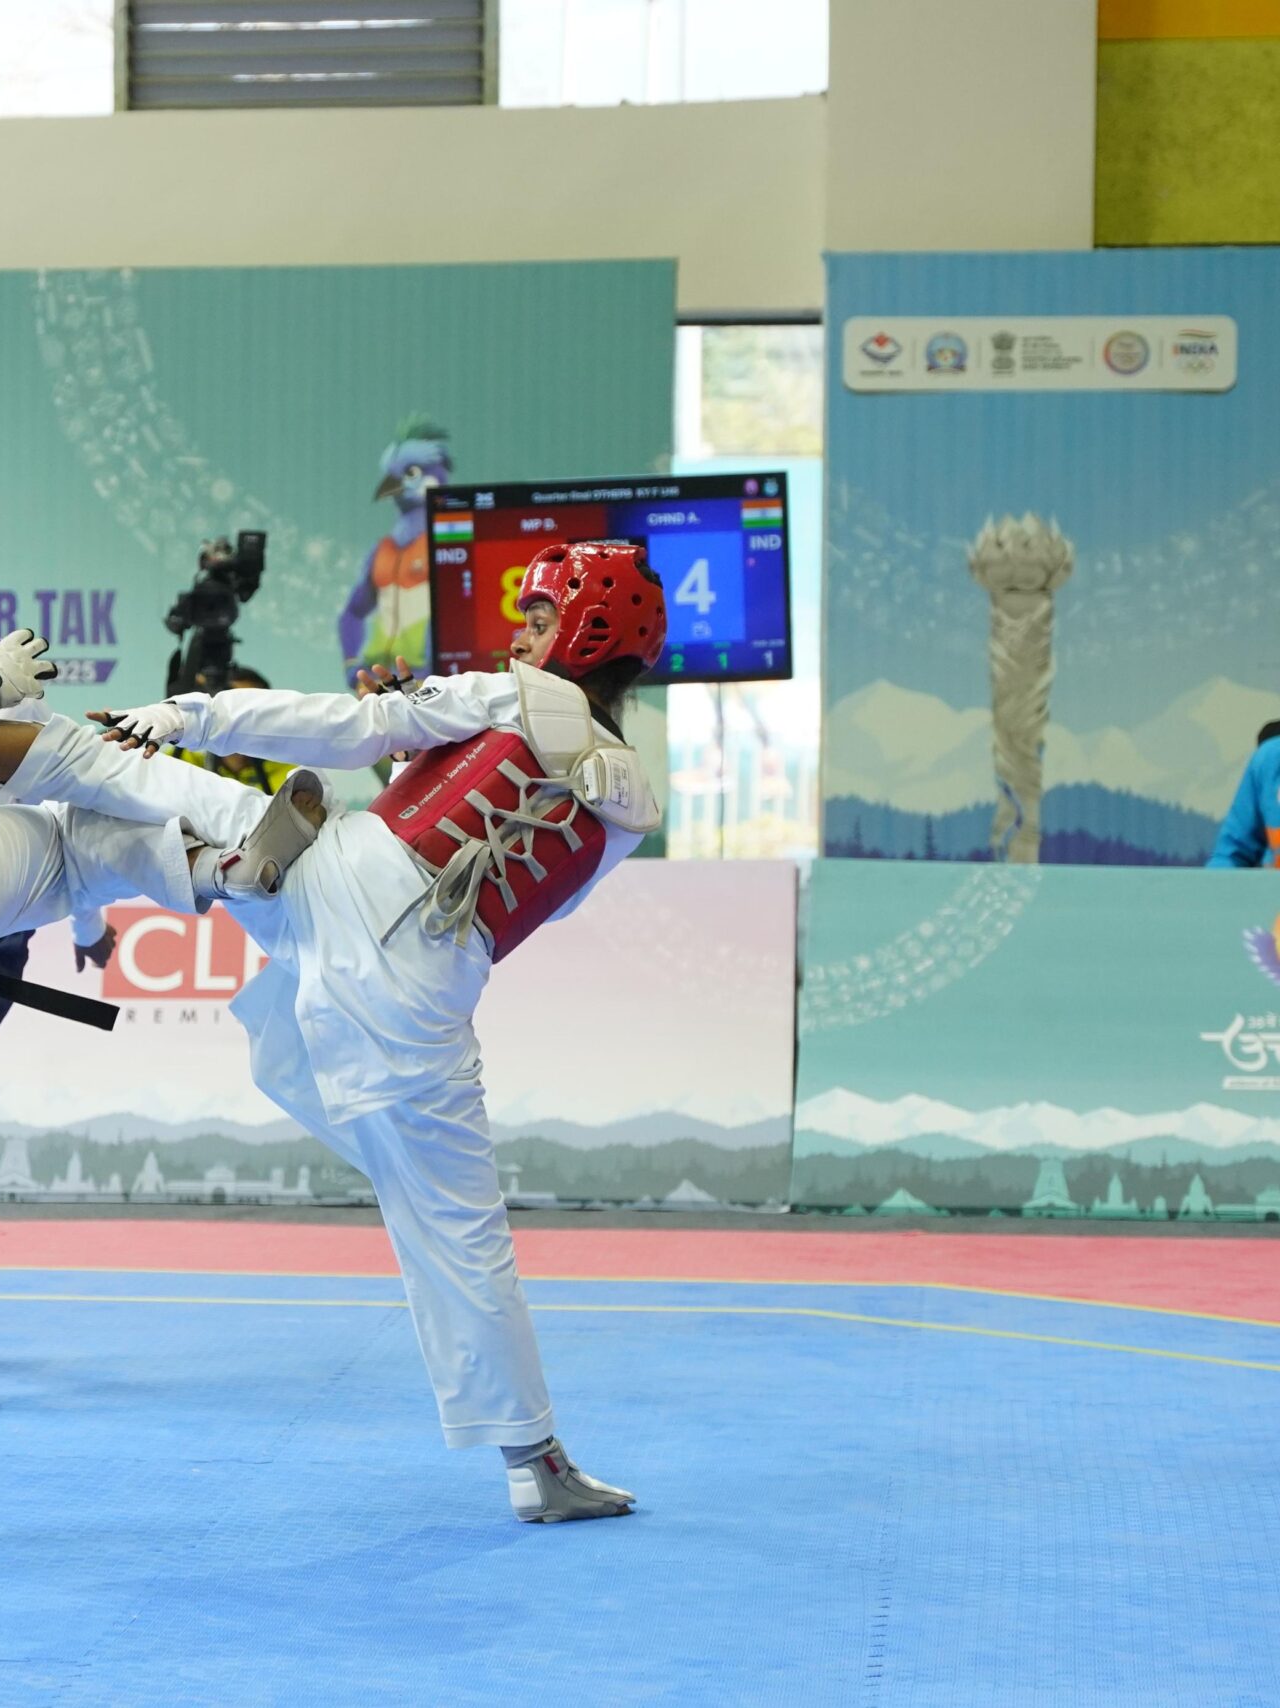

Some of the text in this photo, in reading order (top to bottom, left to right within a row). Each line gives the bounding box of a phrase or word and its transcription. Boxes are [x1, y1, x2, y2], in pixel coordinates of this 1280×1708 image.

[750, 534, 782, 551] IND
[435, 548, 468, 564] IND
[500, 565, 526, 624] 8
[674, 558, 717, 615] 4
[35, 590, 118, 646] TAK
[670, 653, 685, 672] 2
[718, 652, 728, 669] 1
[763, 650, 774, 668] 1
[446, 759, 469, 780] Scoring
[465, 740, 488, 761] System
